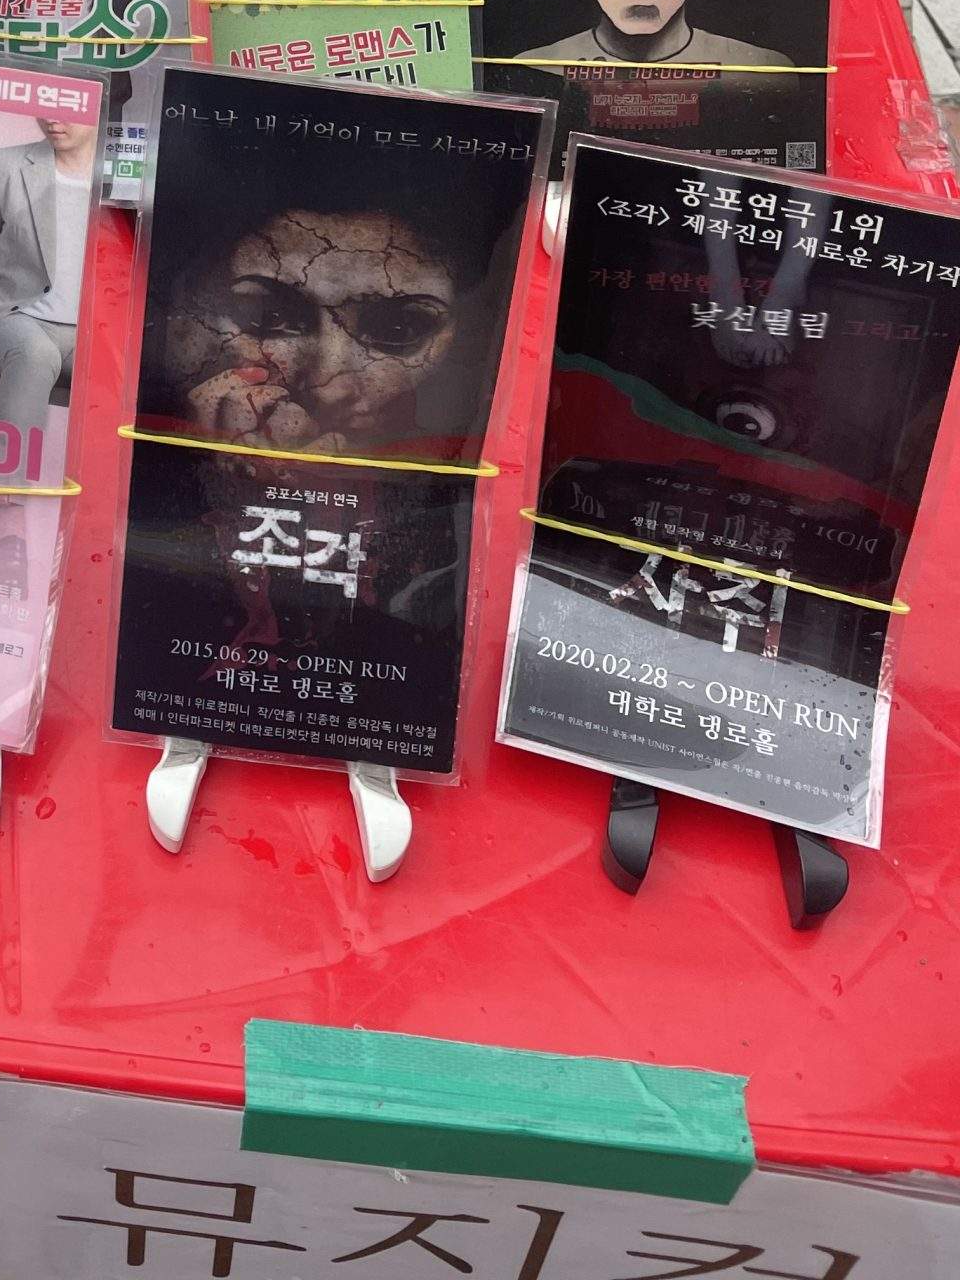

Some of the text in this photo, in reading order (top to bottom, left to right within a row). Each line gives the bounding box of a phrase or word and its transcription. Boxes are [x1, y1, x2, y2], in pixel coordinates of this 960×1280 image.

[229, 21, 447, 72] 새로운 로맨스가
[36, 84, 90, 114] 연극!
[166, 104, 534, 162] 어느날 내 기억이 모두 사라졌다
[675, 178, 885, 245] 공포연극 1위
[681, 213, 785, 252] 제작진의
[792, 235, 873, 270] 새로운
[588, 268, 635, 290] 가장
[265, 486, 359, 508] 공포스릴러 연극
[231, 505, 367, 599] 조각
[171, 638, 407, 682] 2015.06.29 OPEN RUN
[135, 689, 184, 707] 제작/기획
[195, 696, 250, 716] 위로컴퍼니
[257, 706, 296, 723] 작/연출
[347, 716, 392, 734] 음악감독
[216, 668, 359, 705] 대학로 댕로홀
[537, 636, 861, 741] 2020.02.28 OPEN RUN
[133, 707, 435, 757] 예매 인터파크티켓 대학로티켓닷컴 네이버예약 타임티켓
[607, 689, 779, 757] 대학로 댕로홀
[648, 737, 675, 754] UNIST
